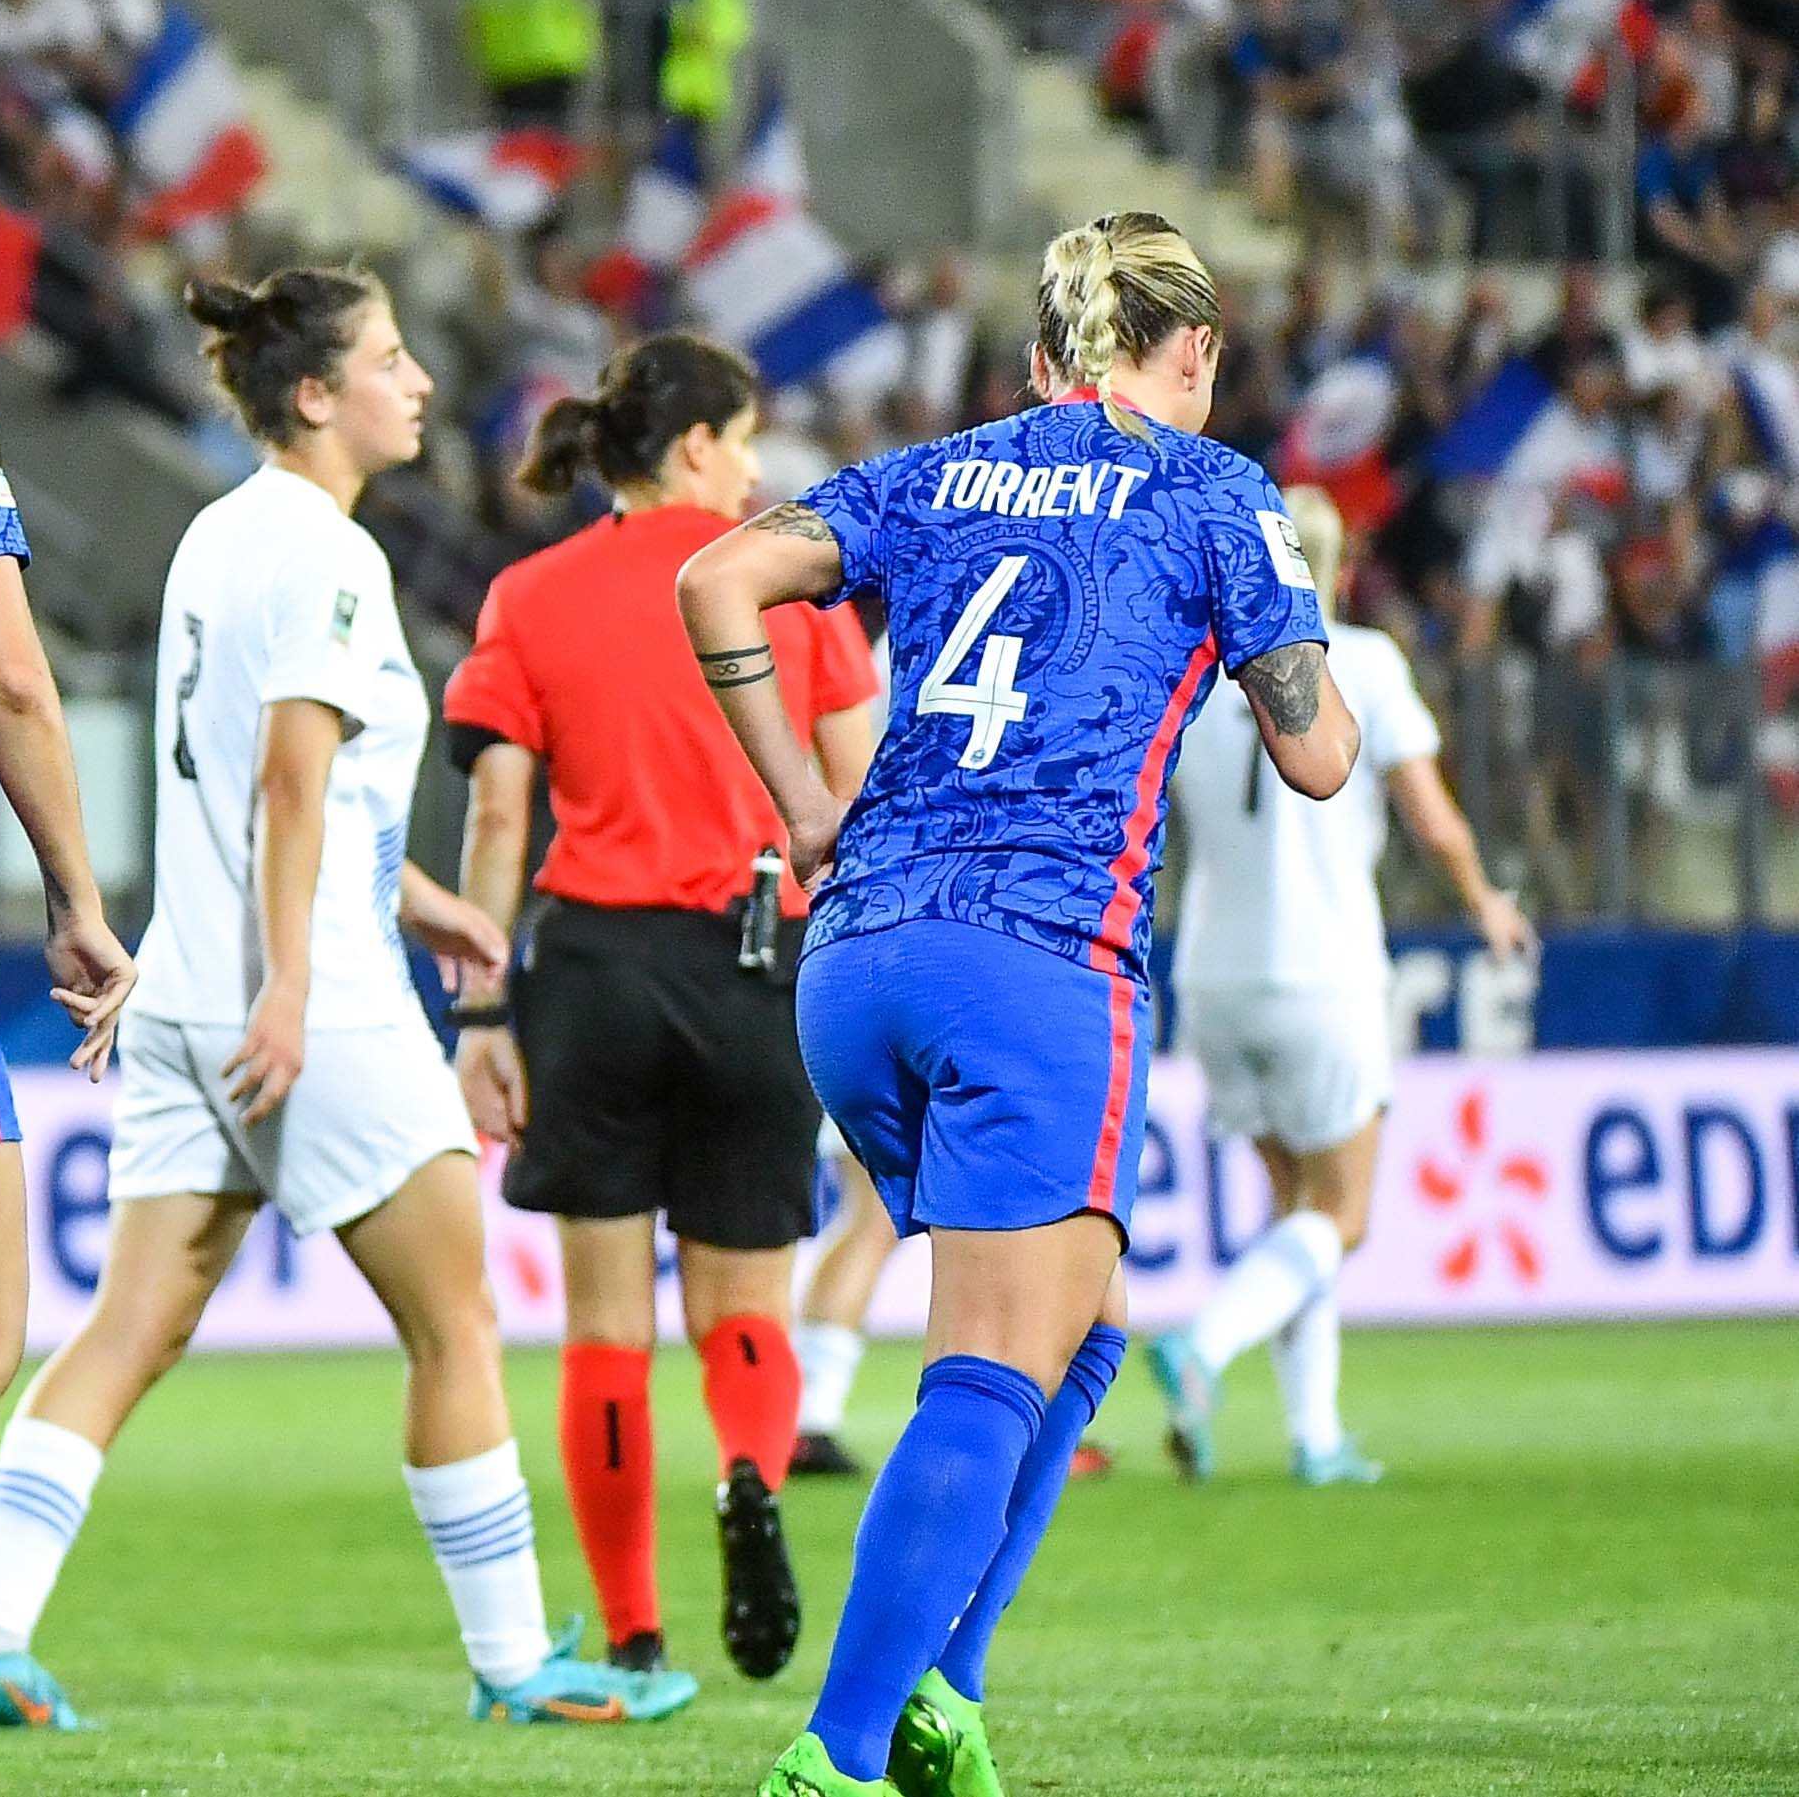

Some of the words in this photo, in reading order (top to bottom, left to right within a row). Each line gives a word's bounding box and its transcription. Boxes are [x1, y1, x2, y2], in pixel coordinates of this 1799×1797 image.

[930, 459, 1150, 520] TORRENT
[916, 555, 1029, 770] 4
[1582, 1101, 1799, 1266] eD
